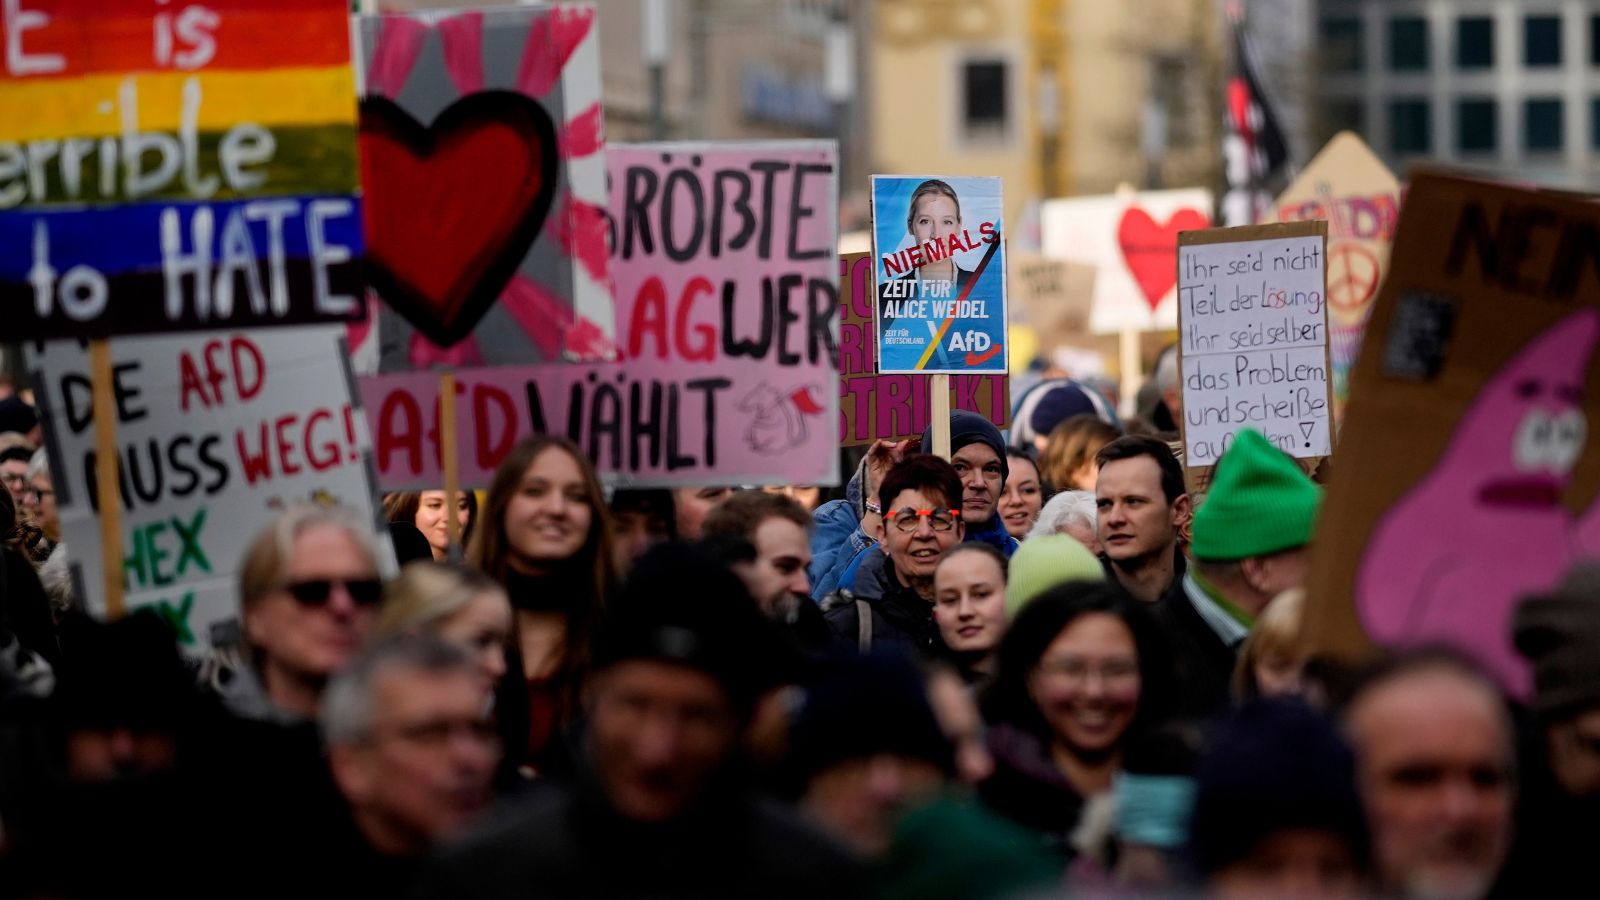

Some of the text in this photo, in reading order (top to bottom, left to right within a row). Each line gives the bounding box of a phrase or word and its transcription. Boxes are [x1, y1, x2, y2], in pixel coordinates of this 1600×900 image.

[153, 0, 221, 67] is
[605, 153, 832, 265] RÖßTE
[27, 199, 358, 320] to HATE
[882, 221, 998, 277] NIEMALS
[1186, 245, 1319, 280] Ihr seid nicht
[883, 280, 951, 297] ZEIT FÜR
[1181, 284, 1225, 317] Teil
[1229, 284, 1259, 311] der
[884, 300, 989, 318] ALICE WEIDEL
[898, 328, 909, 337] FÜR
[947, 330, 991, 352] AfD
[1190, 316, 1322, 350] Ihr seid selber
[1188, 352, 1326, 391] das Problem.
[62, 362, 147, 433] DE
[1188, 396, 1230, 426] und
[235, 404, 358, 488] WEG!
